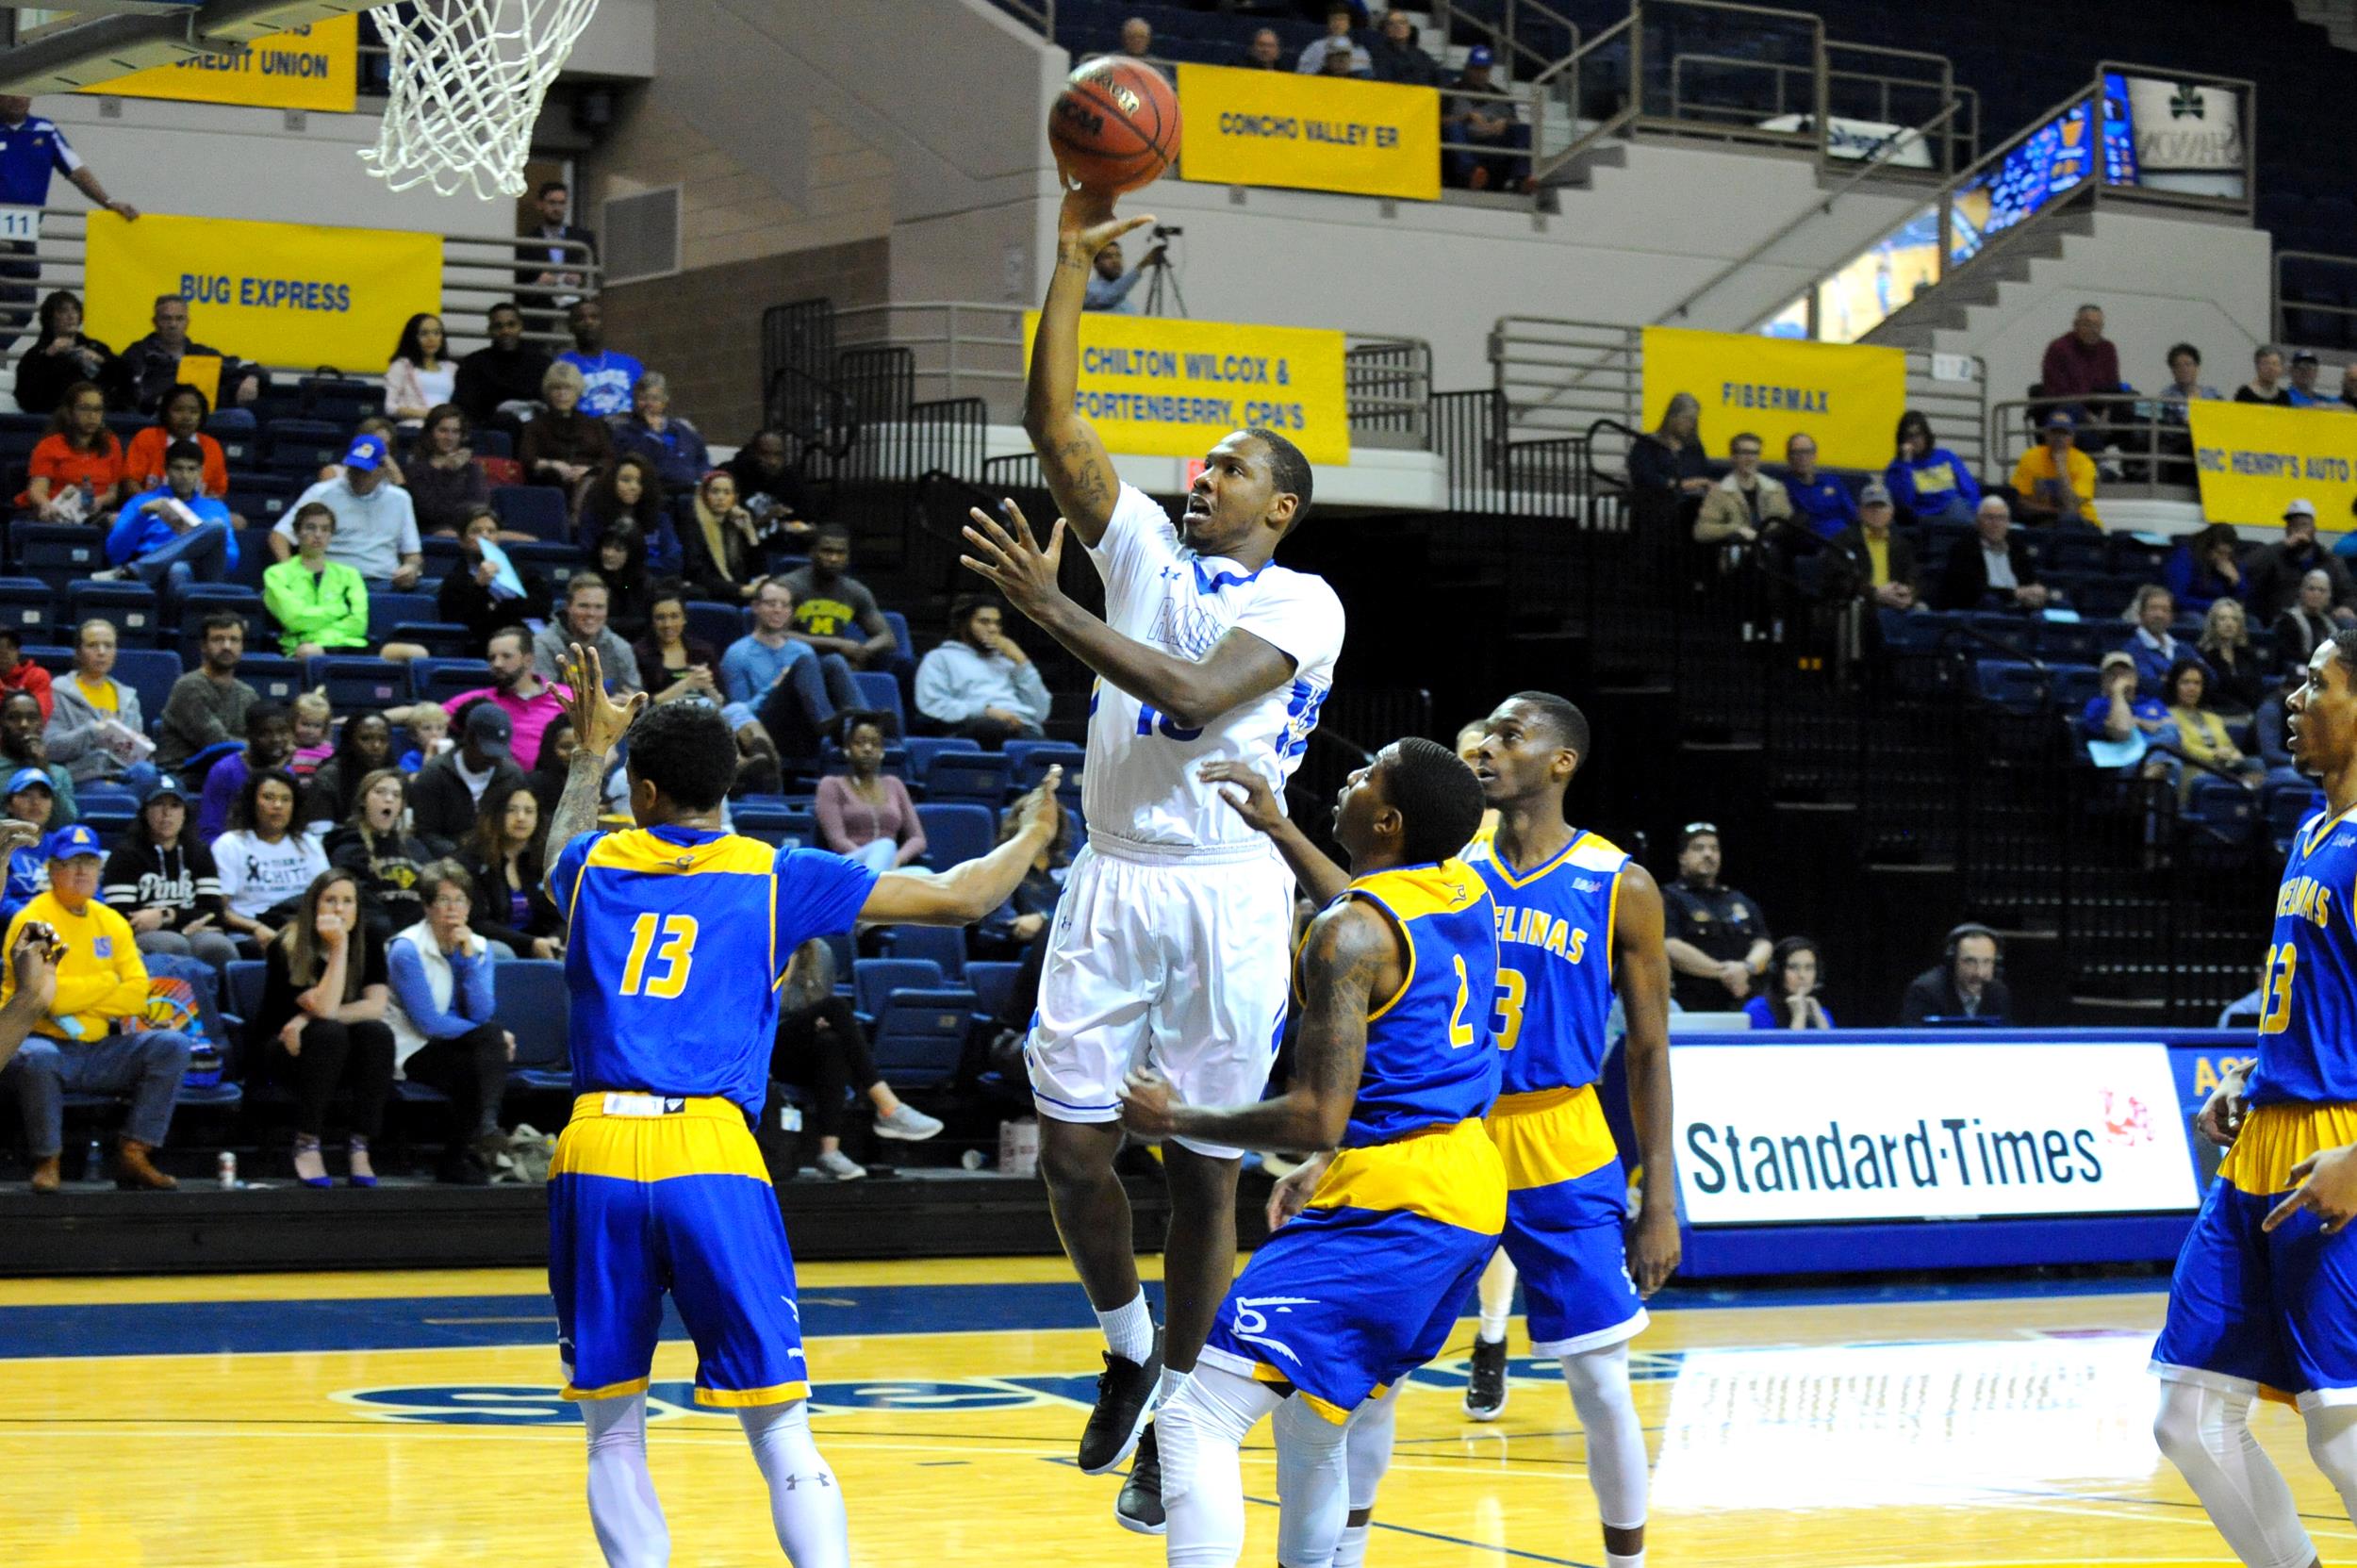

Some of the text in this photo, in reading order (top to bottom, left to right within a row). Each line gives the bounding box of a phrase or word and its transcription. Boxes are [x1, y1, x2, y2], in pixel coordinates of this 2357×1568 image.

[175, 48, 329, 78] REDIT UNION
[1220, 111, 1400, 148] CONCHO VALLEY ER
[180, 274, 351, 313] BUG EXPRESS
[1084, 347, 1291, 387] CHILTON WILCOX &
[1244, 401, 1306, 431] CPA'S
[1722, 382, 1829, 414] FIBERMAX
[2232, 450, 2300, 480] HENRY'S
[2306, 457, 2349, 484] AUTO
[618, 912, 700, 999] 13
[1449, 953, 1475, 1049] 2
